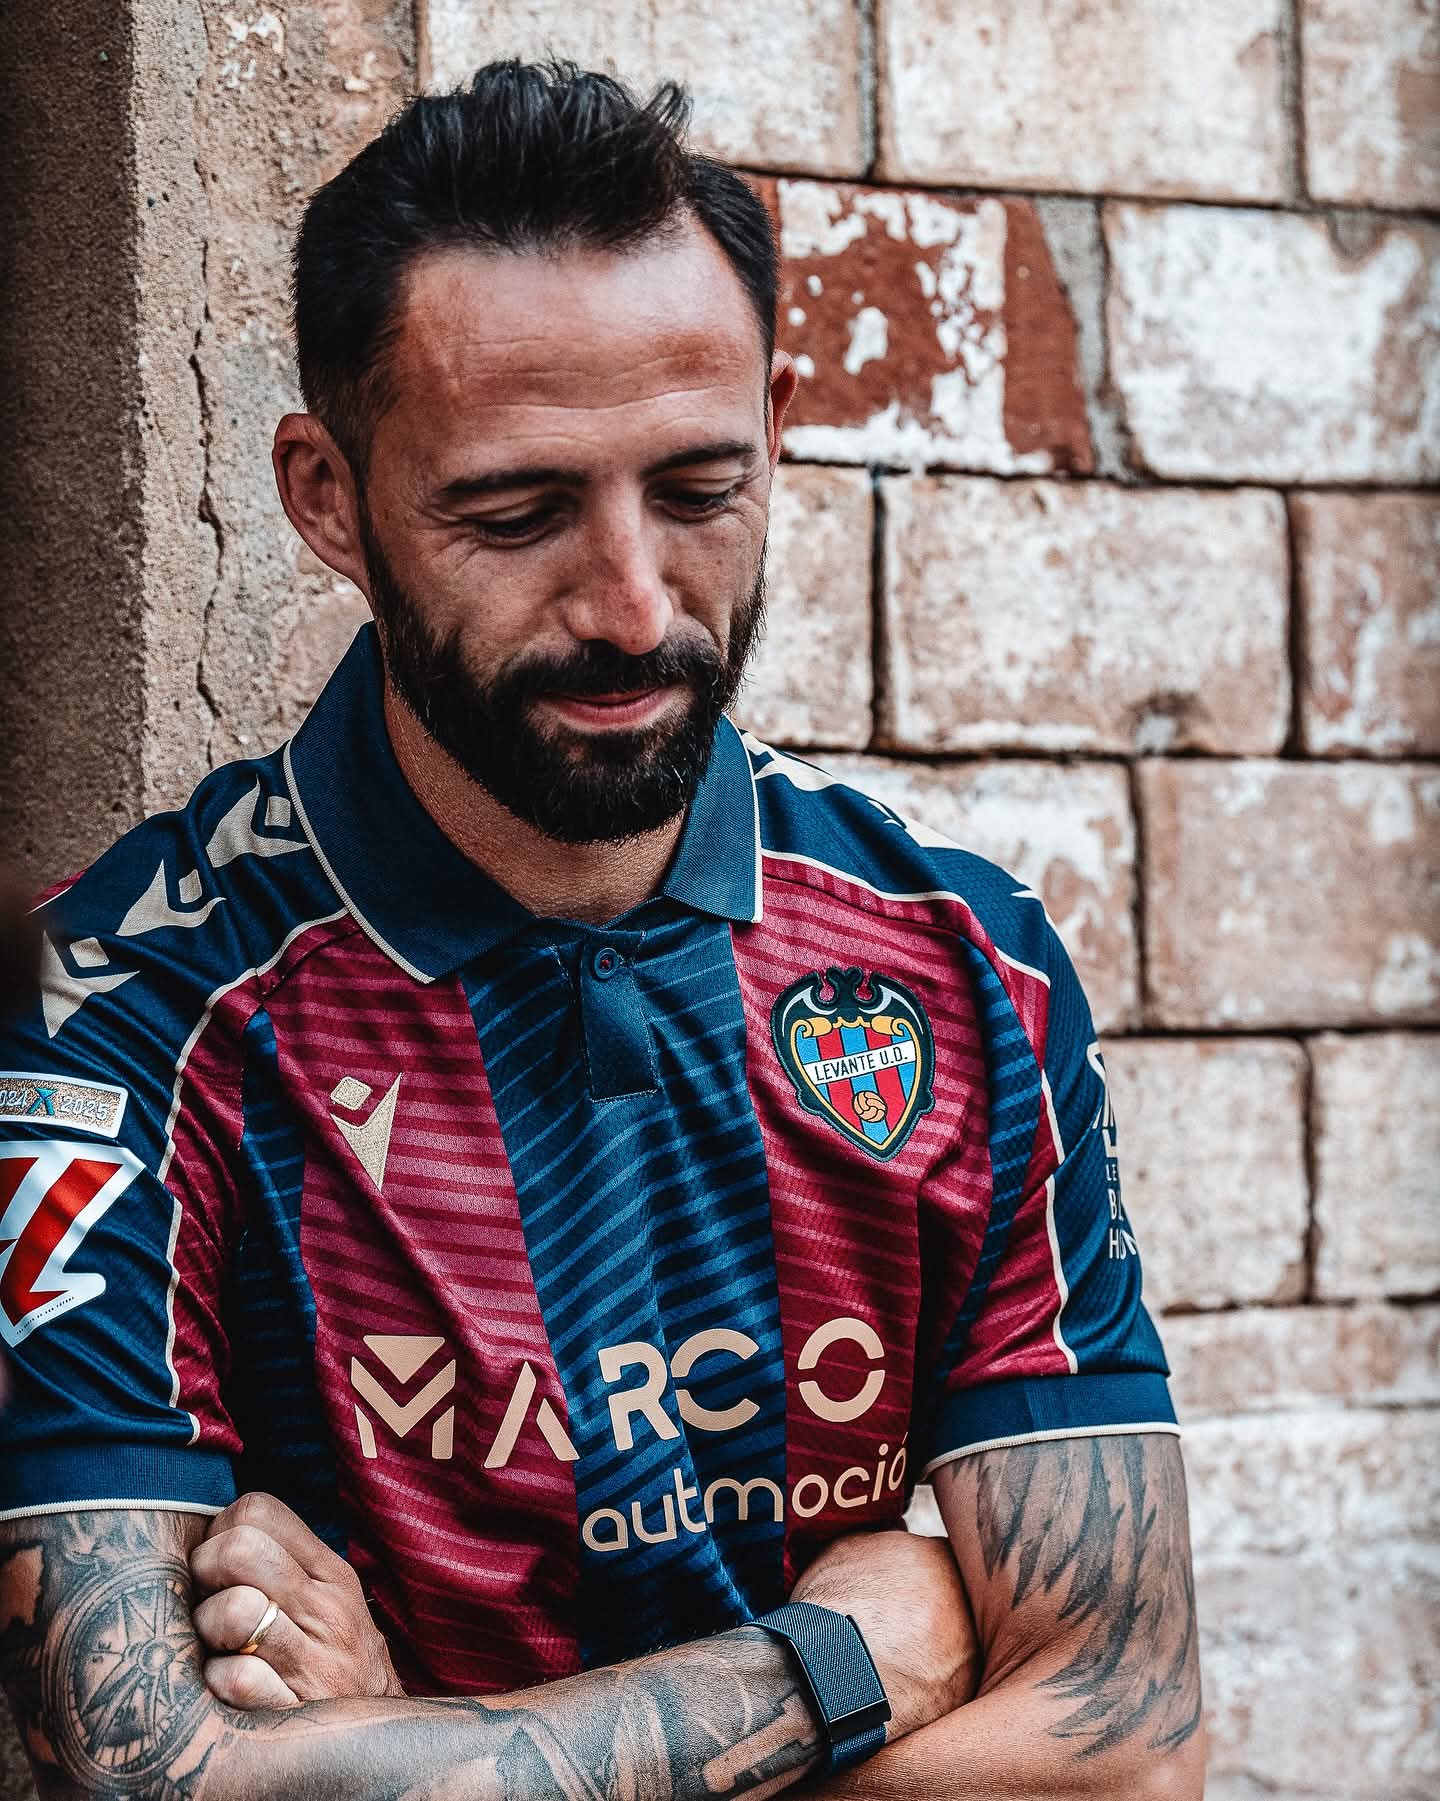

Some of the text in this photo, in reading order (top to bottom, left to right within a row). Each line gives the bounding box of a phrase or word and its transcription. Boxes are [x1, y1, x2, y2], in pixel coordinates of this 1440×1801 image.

[814, 1046, 909, 1081] LEVANTE U.D.
[59, 1095, 109, 1121] 2025
[581, 1431, 909, 1552] autmoció
